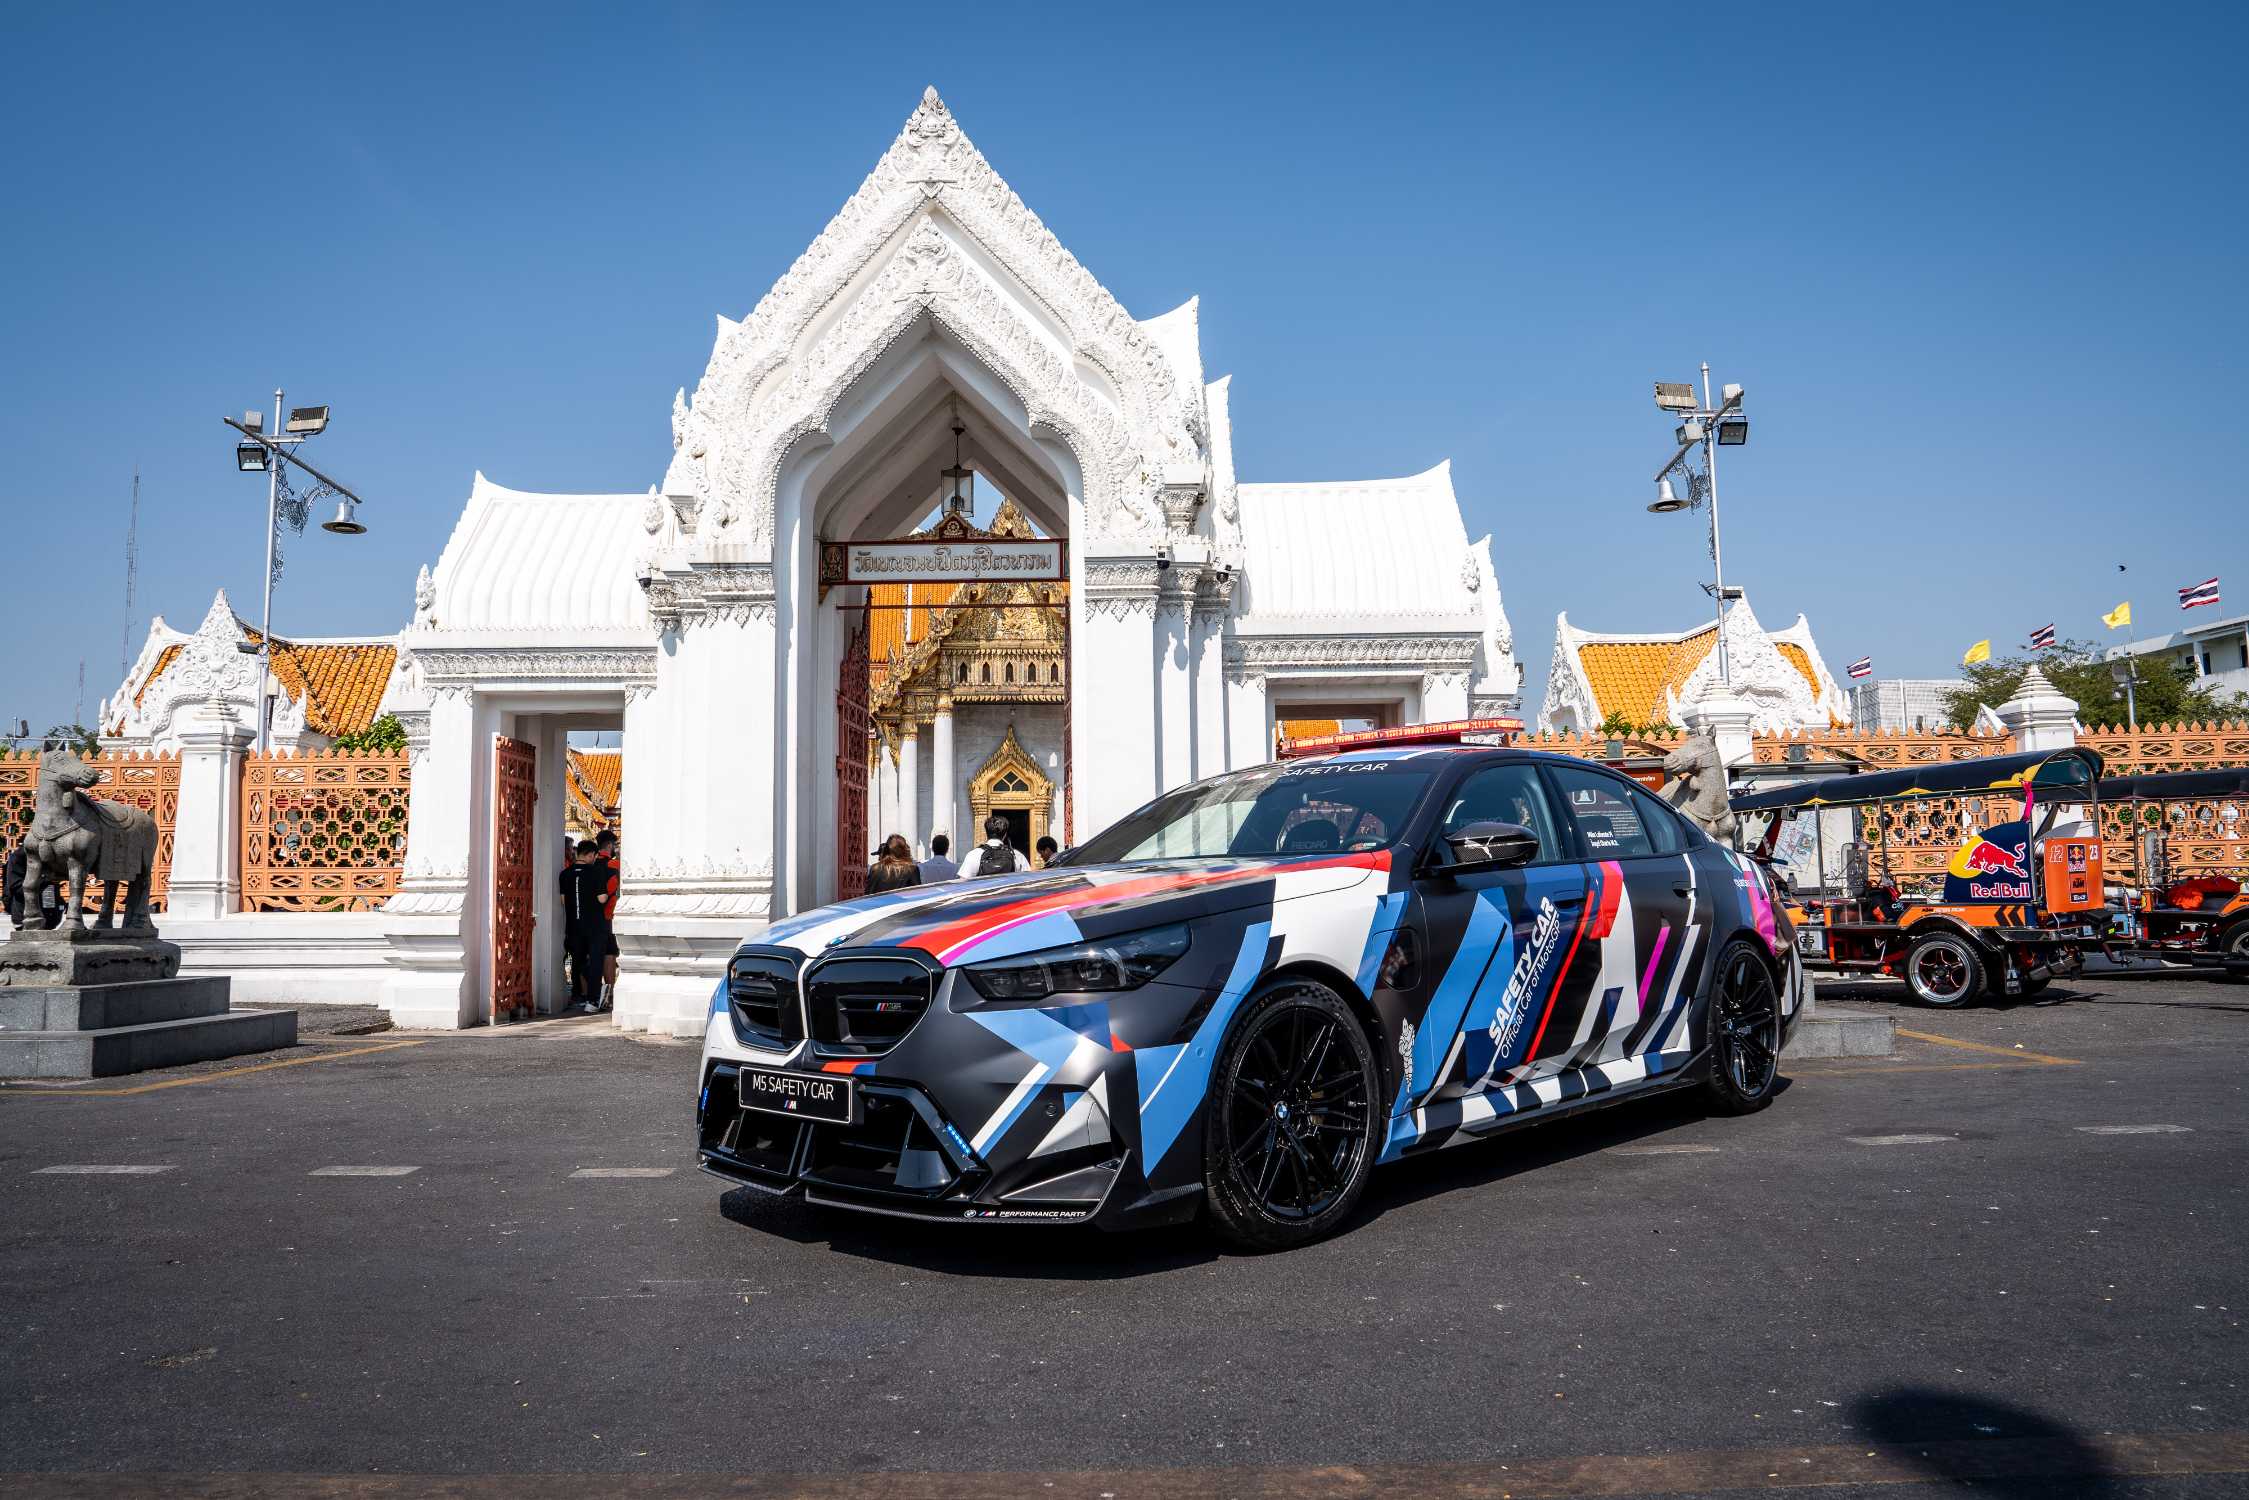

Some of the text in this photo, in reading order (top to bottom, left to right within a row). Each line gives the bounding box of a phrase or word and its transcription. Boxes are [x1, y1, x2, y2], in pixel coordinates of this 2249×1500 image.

[1282, 764, 1347, 777] SAFETY
[1348, 763, 1388, 772] CAR
[2089, 845, 2098, 860] 23
[1971, 883, 2030, 897] Red Bull
[1489, 897, 1554, 1046] SAFETY CAR
[1501, 1008, 1525, 1058] Official
[1520, 985, 1533, 1010] Car
[1531, 970, 1540, 988] of
[752, 1074, 834, 1101] M5 SAFETY CAR
